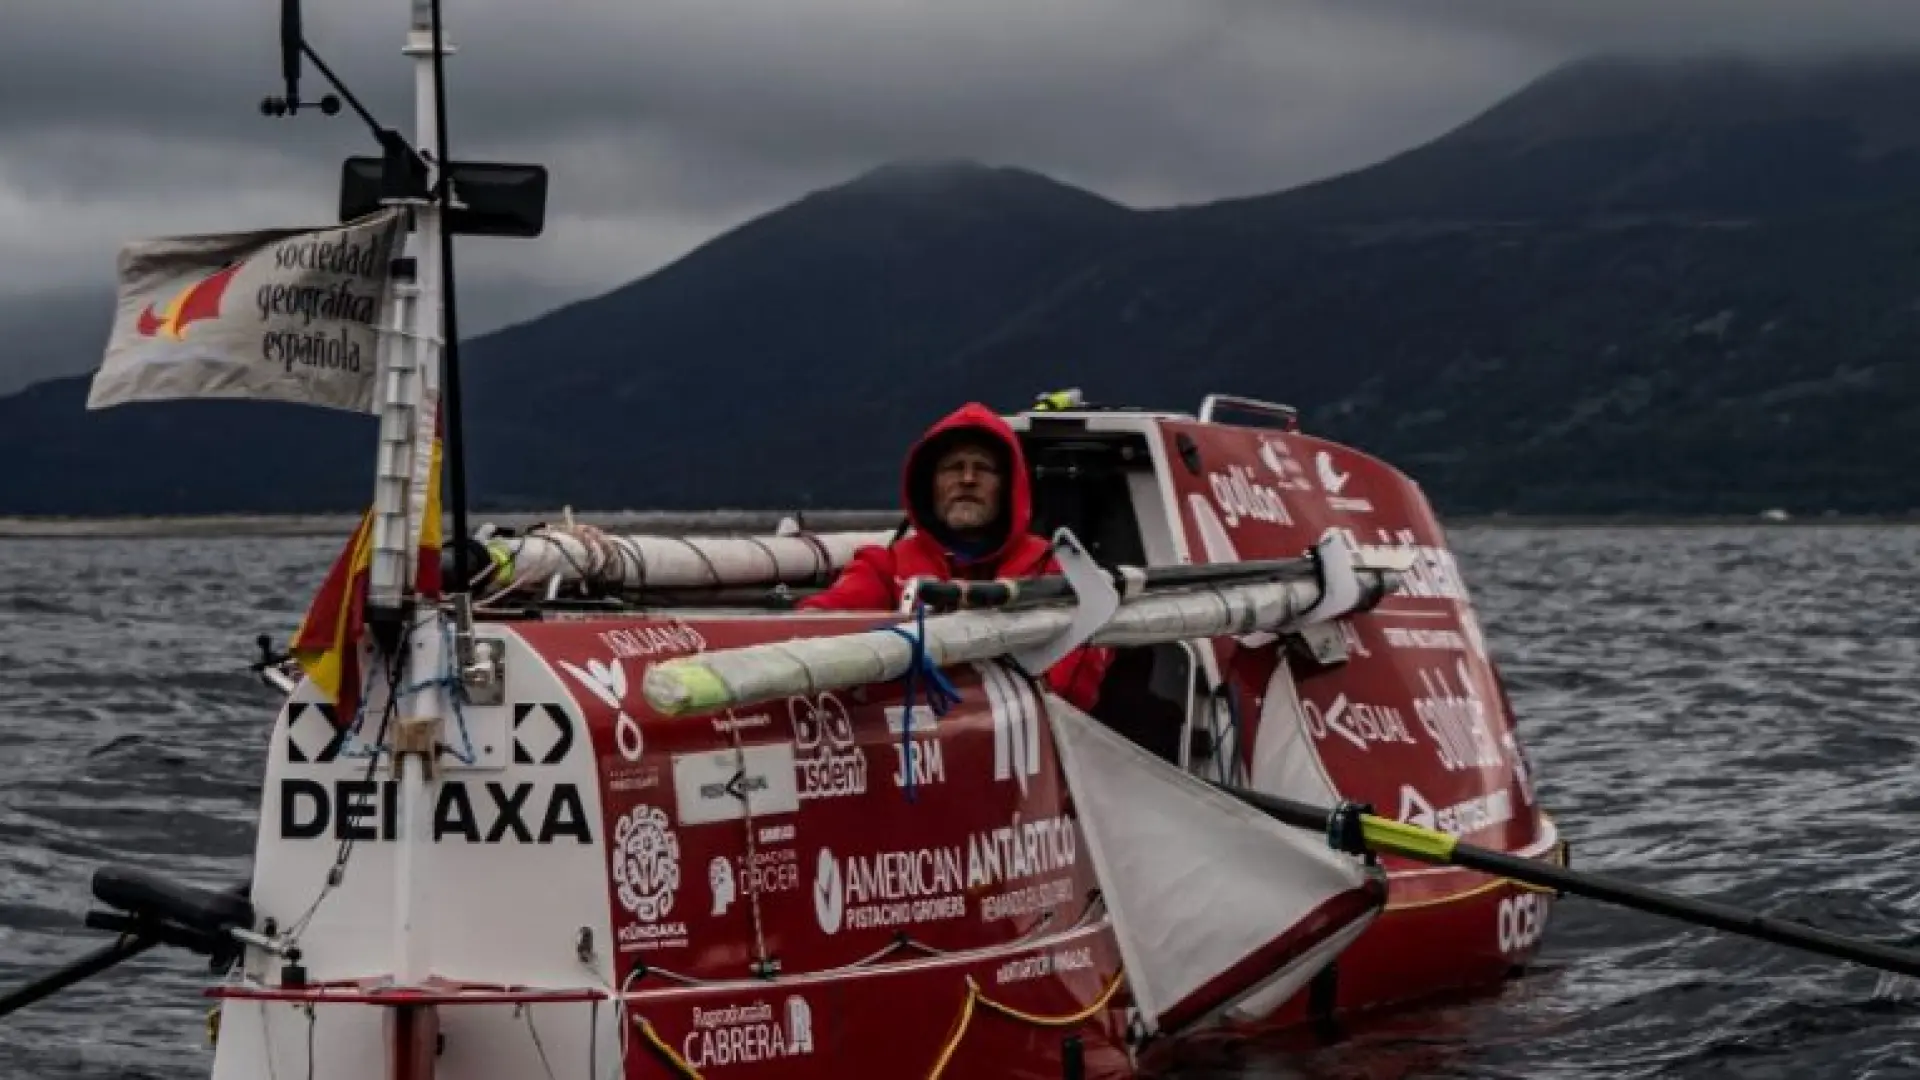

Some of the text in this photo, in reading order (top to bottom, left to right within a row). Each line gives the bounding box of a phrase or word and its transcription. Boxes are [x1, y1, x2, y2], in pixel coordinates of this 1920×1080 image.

[273, 232, 379, 278] sociedad
[256, 280, 374, 324] geográfica
[263, 328, 360, 372] española
[892, 739, 945, 788] JRM
[967, 811, 1077, 889] ANTÁRTICO
[846, 846, 963, 904] AMERICAN
[846, 900, 911, 930] PISTACHIO
[683, 1022, 787, 1068] CABRERA
